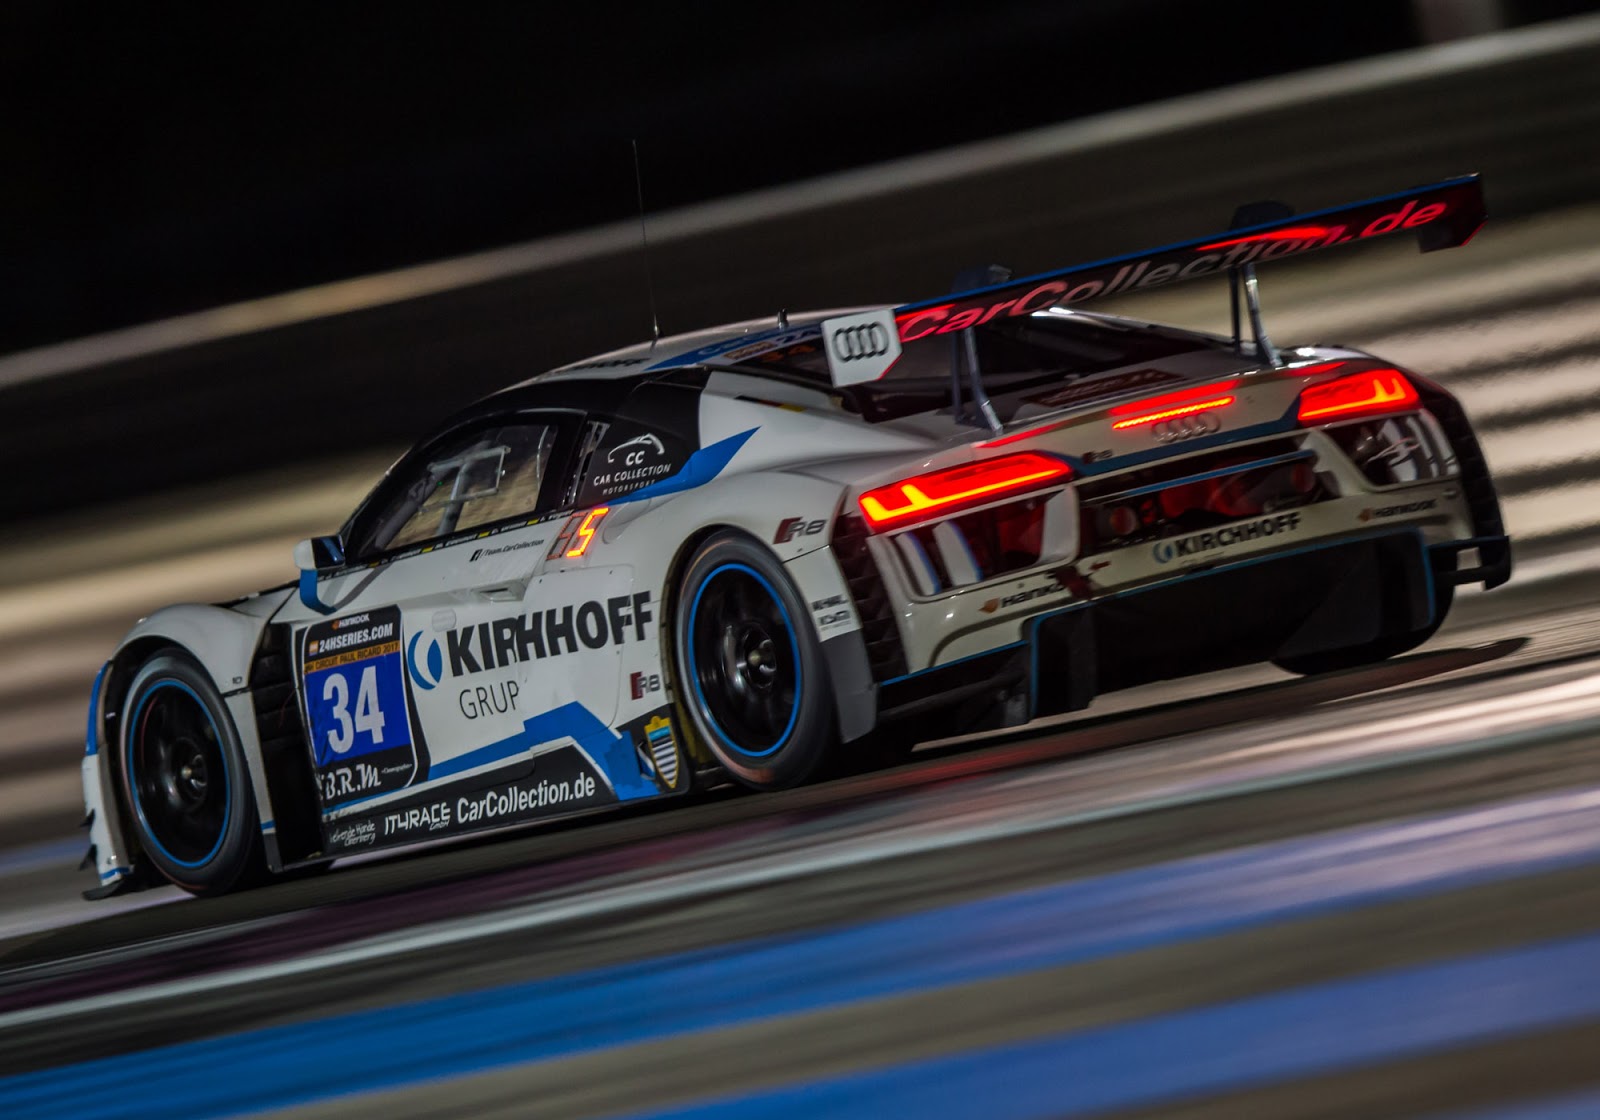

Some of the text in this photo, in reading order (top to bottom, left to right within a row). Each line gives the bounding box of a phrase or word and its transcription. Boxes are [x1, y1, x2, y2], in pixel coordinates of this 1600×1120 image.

[593, 463, 672, 487] CAR COLLECTION
[602, 479, 656, 496] MOTORSPORT
[1175, 511, 1300, 557] KIRCHHOFF
[319, 622, 394, 653] 24HSERIES.COM
[340, 652, 354, 664] PAUL
[357, 646, 381, 659] RICARD
[383, 642, 398, 653] 2017
[323, 665, 385, 754] 34
[457, 772, 595, 824] CarCollection.de
